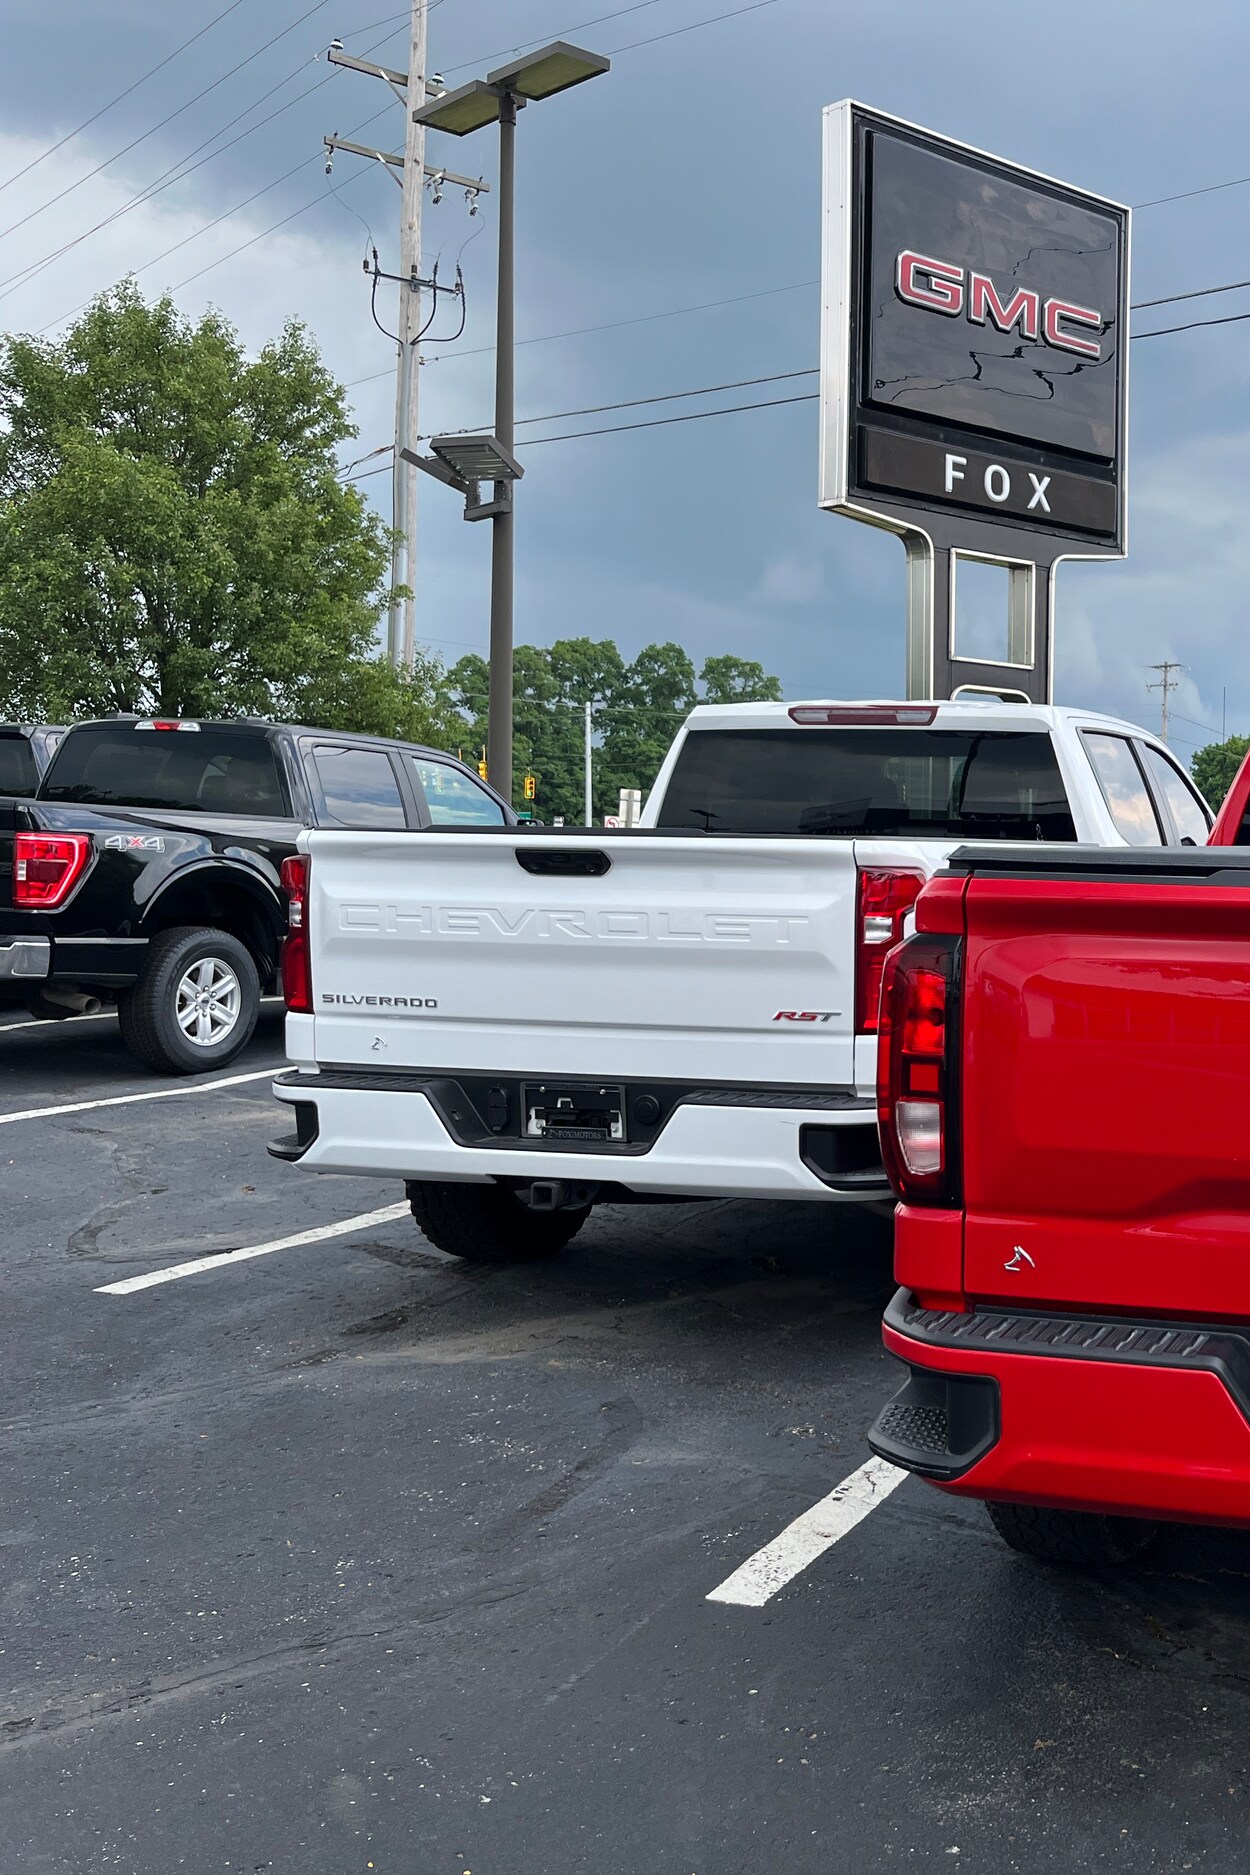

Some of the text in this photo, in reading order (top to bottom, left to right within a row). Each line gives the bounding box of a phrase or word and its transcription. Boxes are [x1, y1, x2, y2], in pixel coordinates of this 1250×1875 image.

[895, 249, 1103, 359] GMC
[943, 453, 1052, 513] FOX
[337, 903, 810, 944] CHEVROLET
[322, 993, 438, 1008] SILVERADO
[772, 1010, 842, 1022] RST
